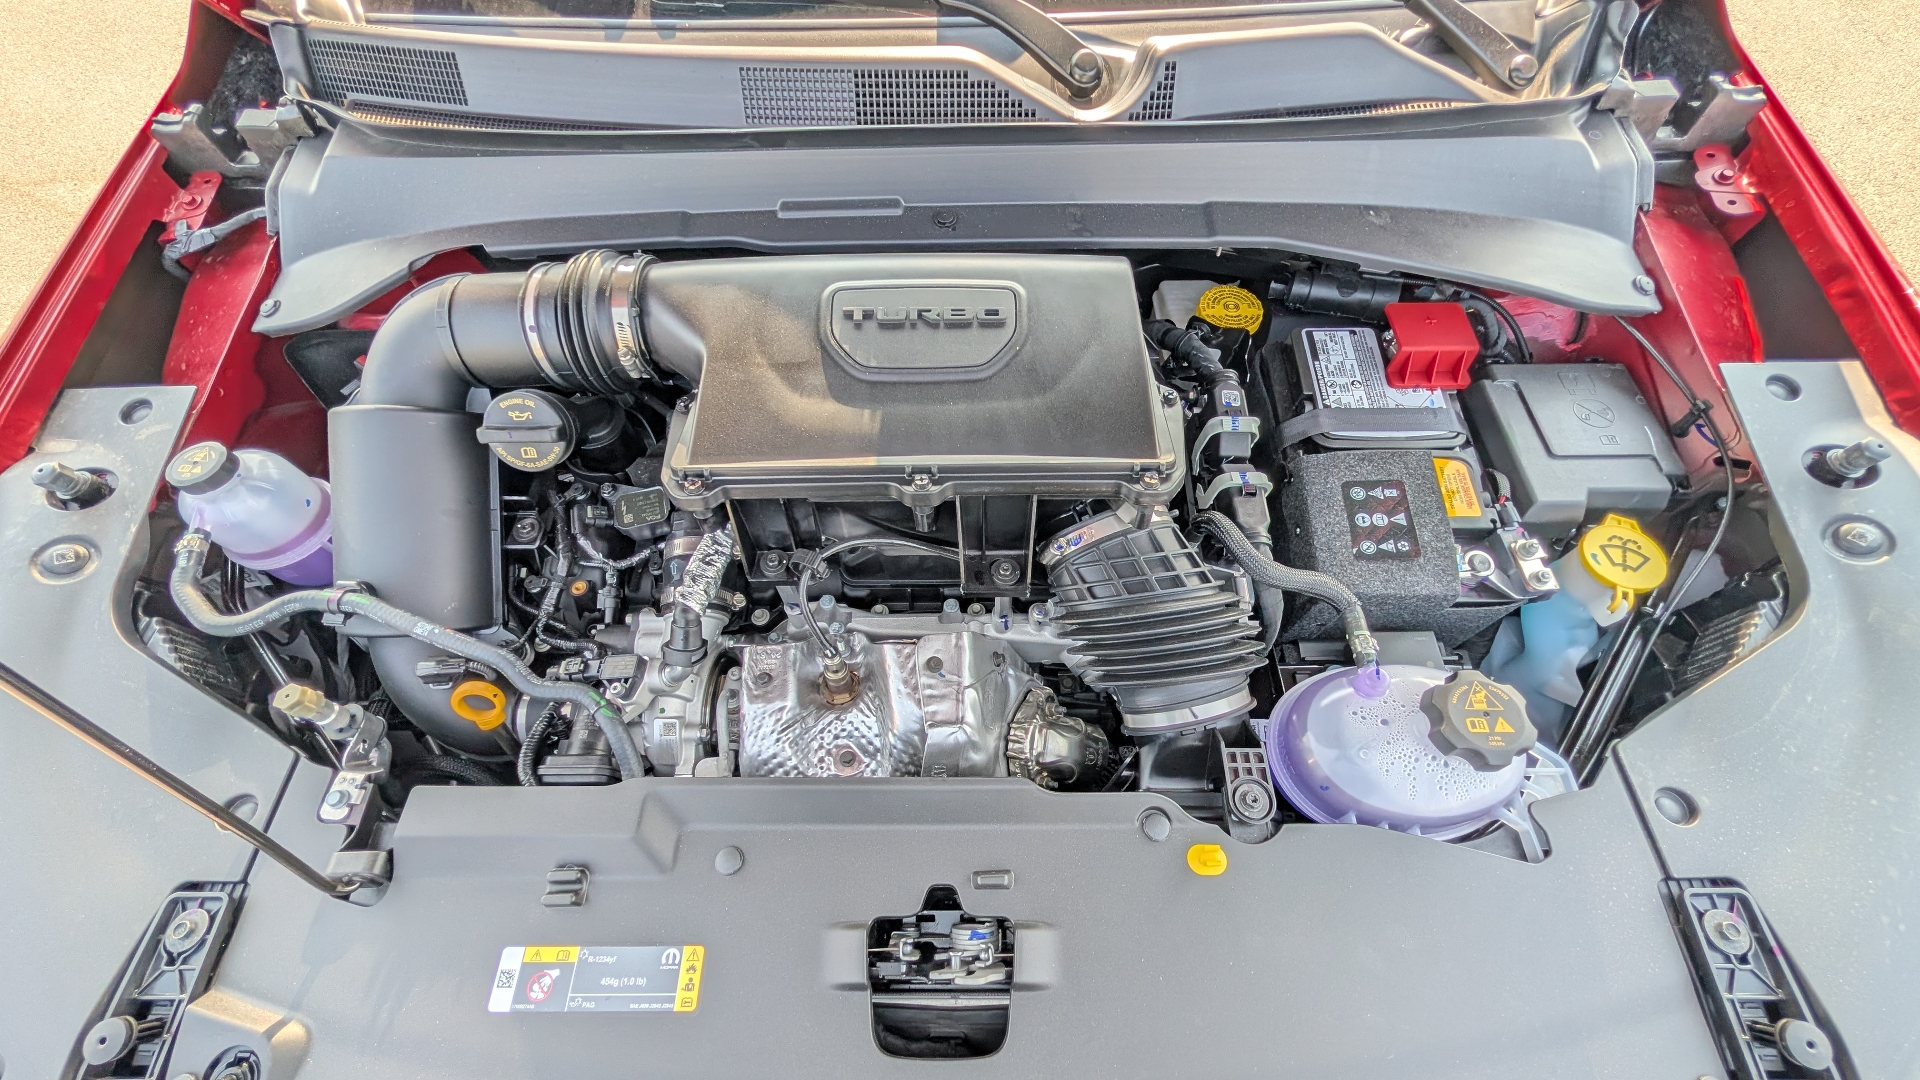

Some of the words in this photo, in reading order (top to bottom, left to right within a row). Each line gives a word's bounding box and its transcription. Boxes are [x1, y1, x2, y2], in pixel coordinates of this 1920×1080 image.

[843, 306, 1007, 326] TURBO
[499, 398, 524, 408] ENGINE
[524, 400, 536, 408] OIL
[496, 448, 506, 458] API
[234, 619, 265, 636] HEATER
[588, 956, 617, 964] R-1234yf
[600, 978, 619, 987] 454g
[620, 977, 635, 987] (1.0
[636, 977, 647, 987] lb)
